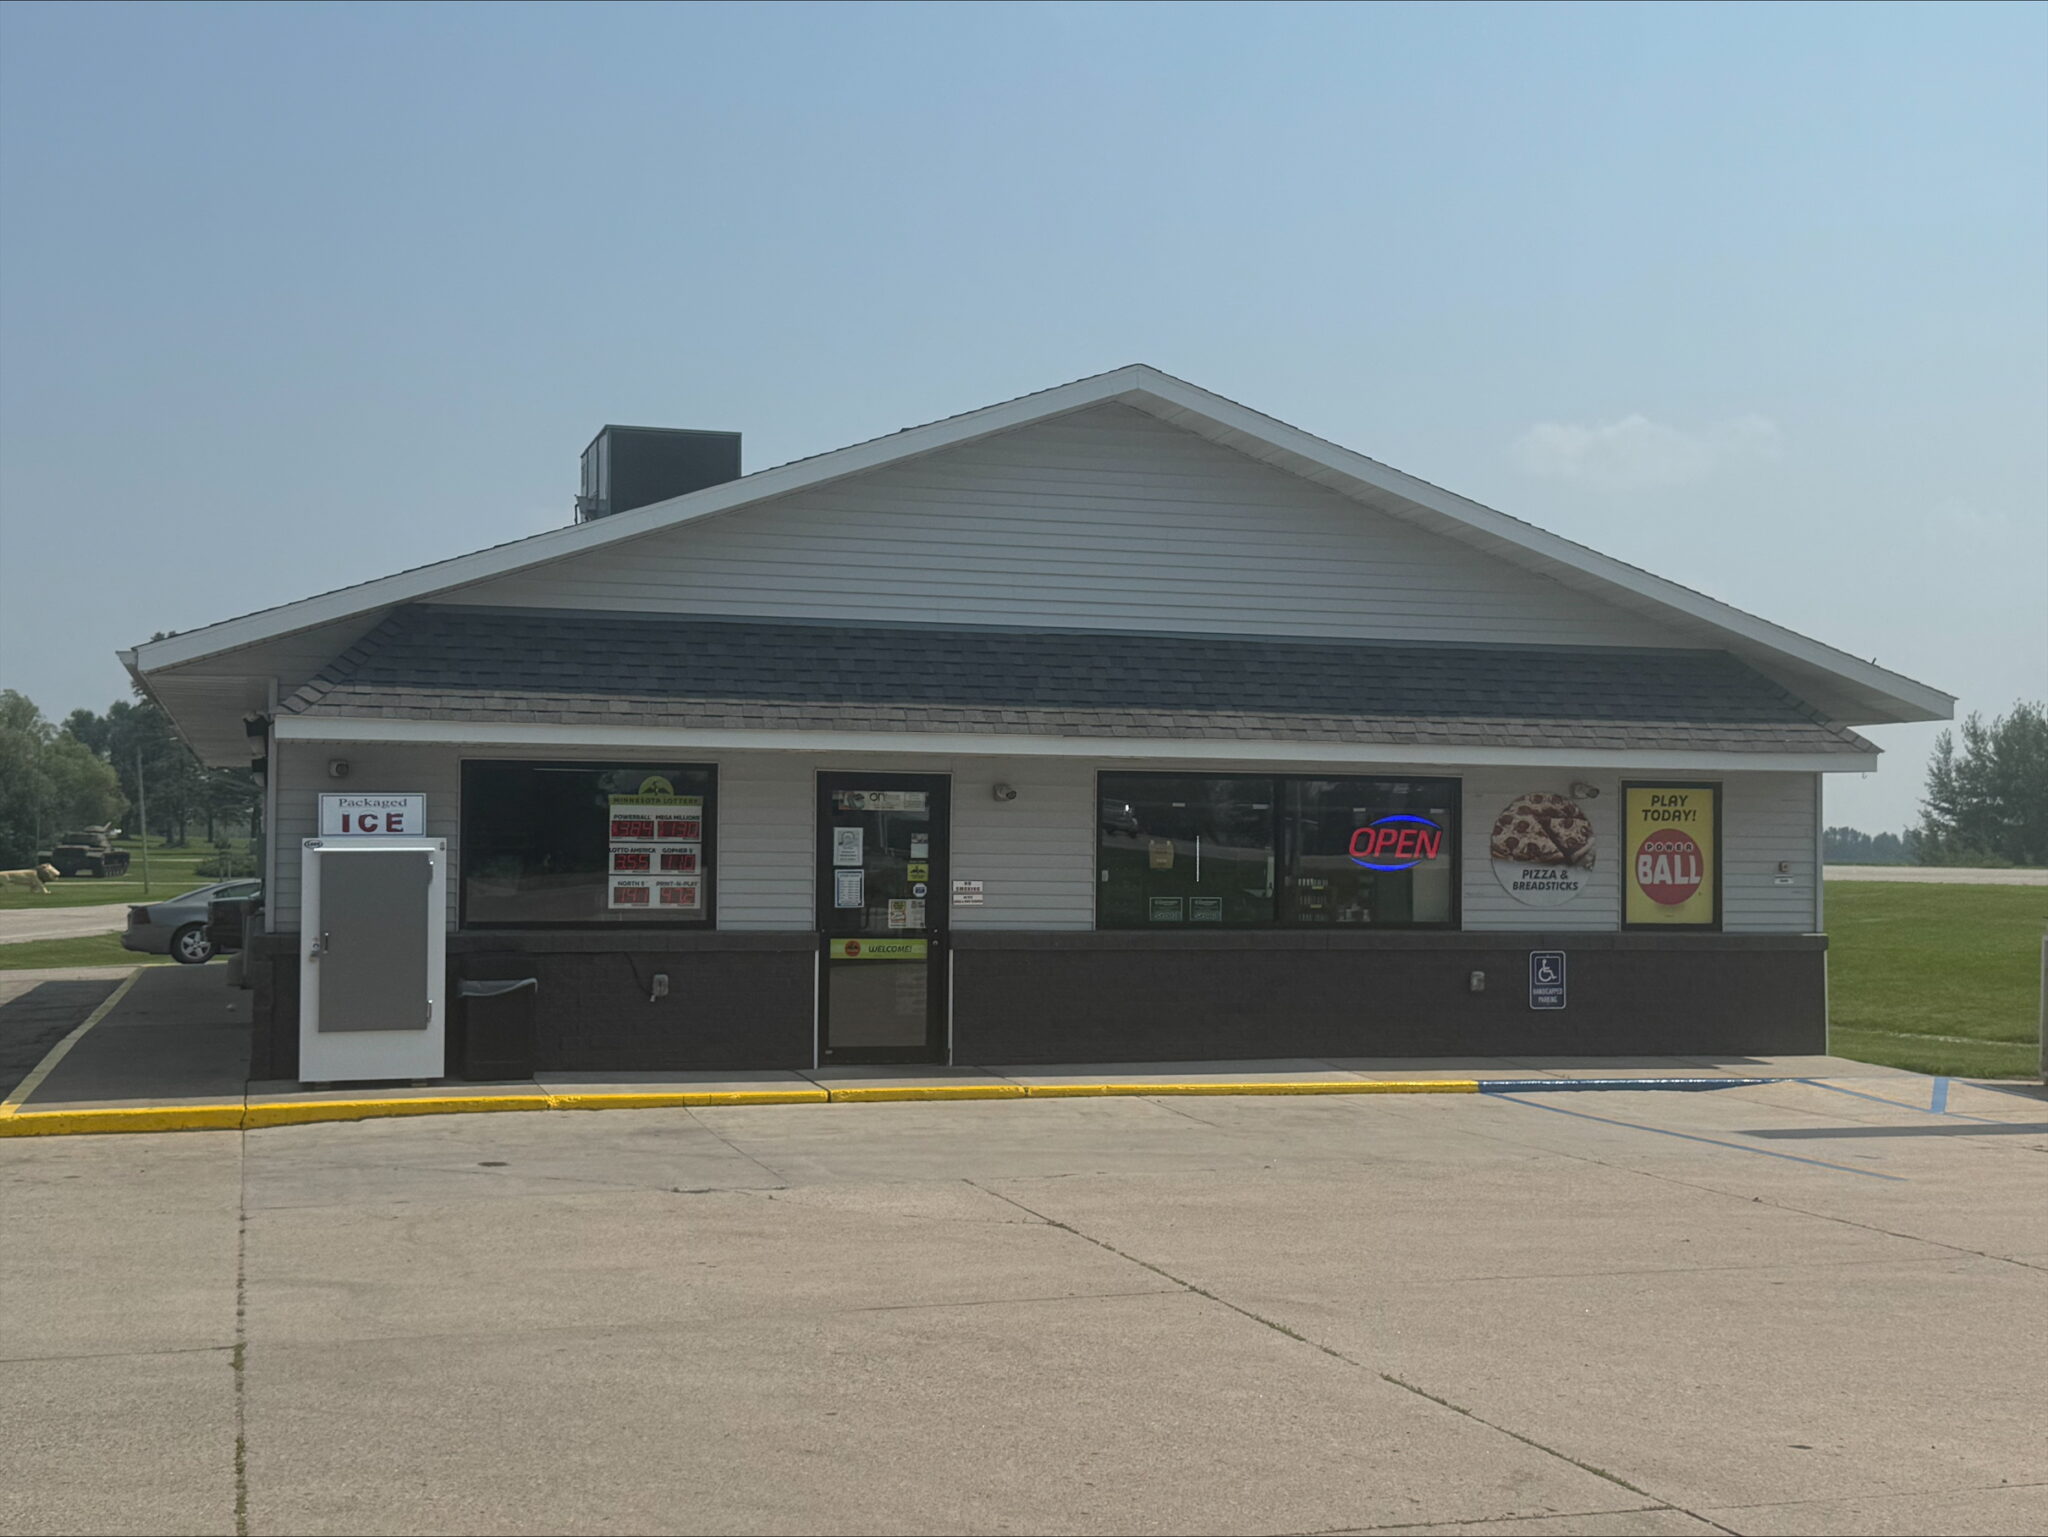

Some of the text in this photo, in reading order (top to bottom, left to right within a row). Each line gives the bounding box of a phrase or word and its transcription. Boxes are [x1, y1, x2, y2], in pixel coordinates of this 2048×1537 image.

[339, 798, 407, 808] Packaged
[1651, 795, 1688, 807] PLAY
[1642, 809, 1697, 822] TODAY!
[342, 813, 404, 833] ICE
[1349, 827, 1442, 859] OPEN
[1645, 842, 1694, 852] POWER
[1522, 869, 1569, 879] PIZZA &
[1637, 854, 1701, 885] BALL
[1512, 881, 1579, 891] BREADSTICKS
